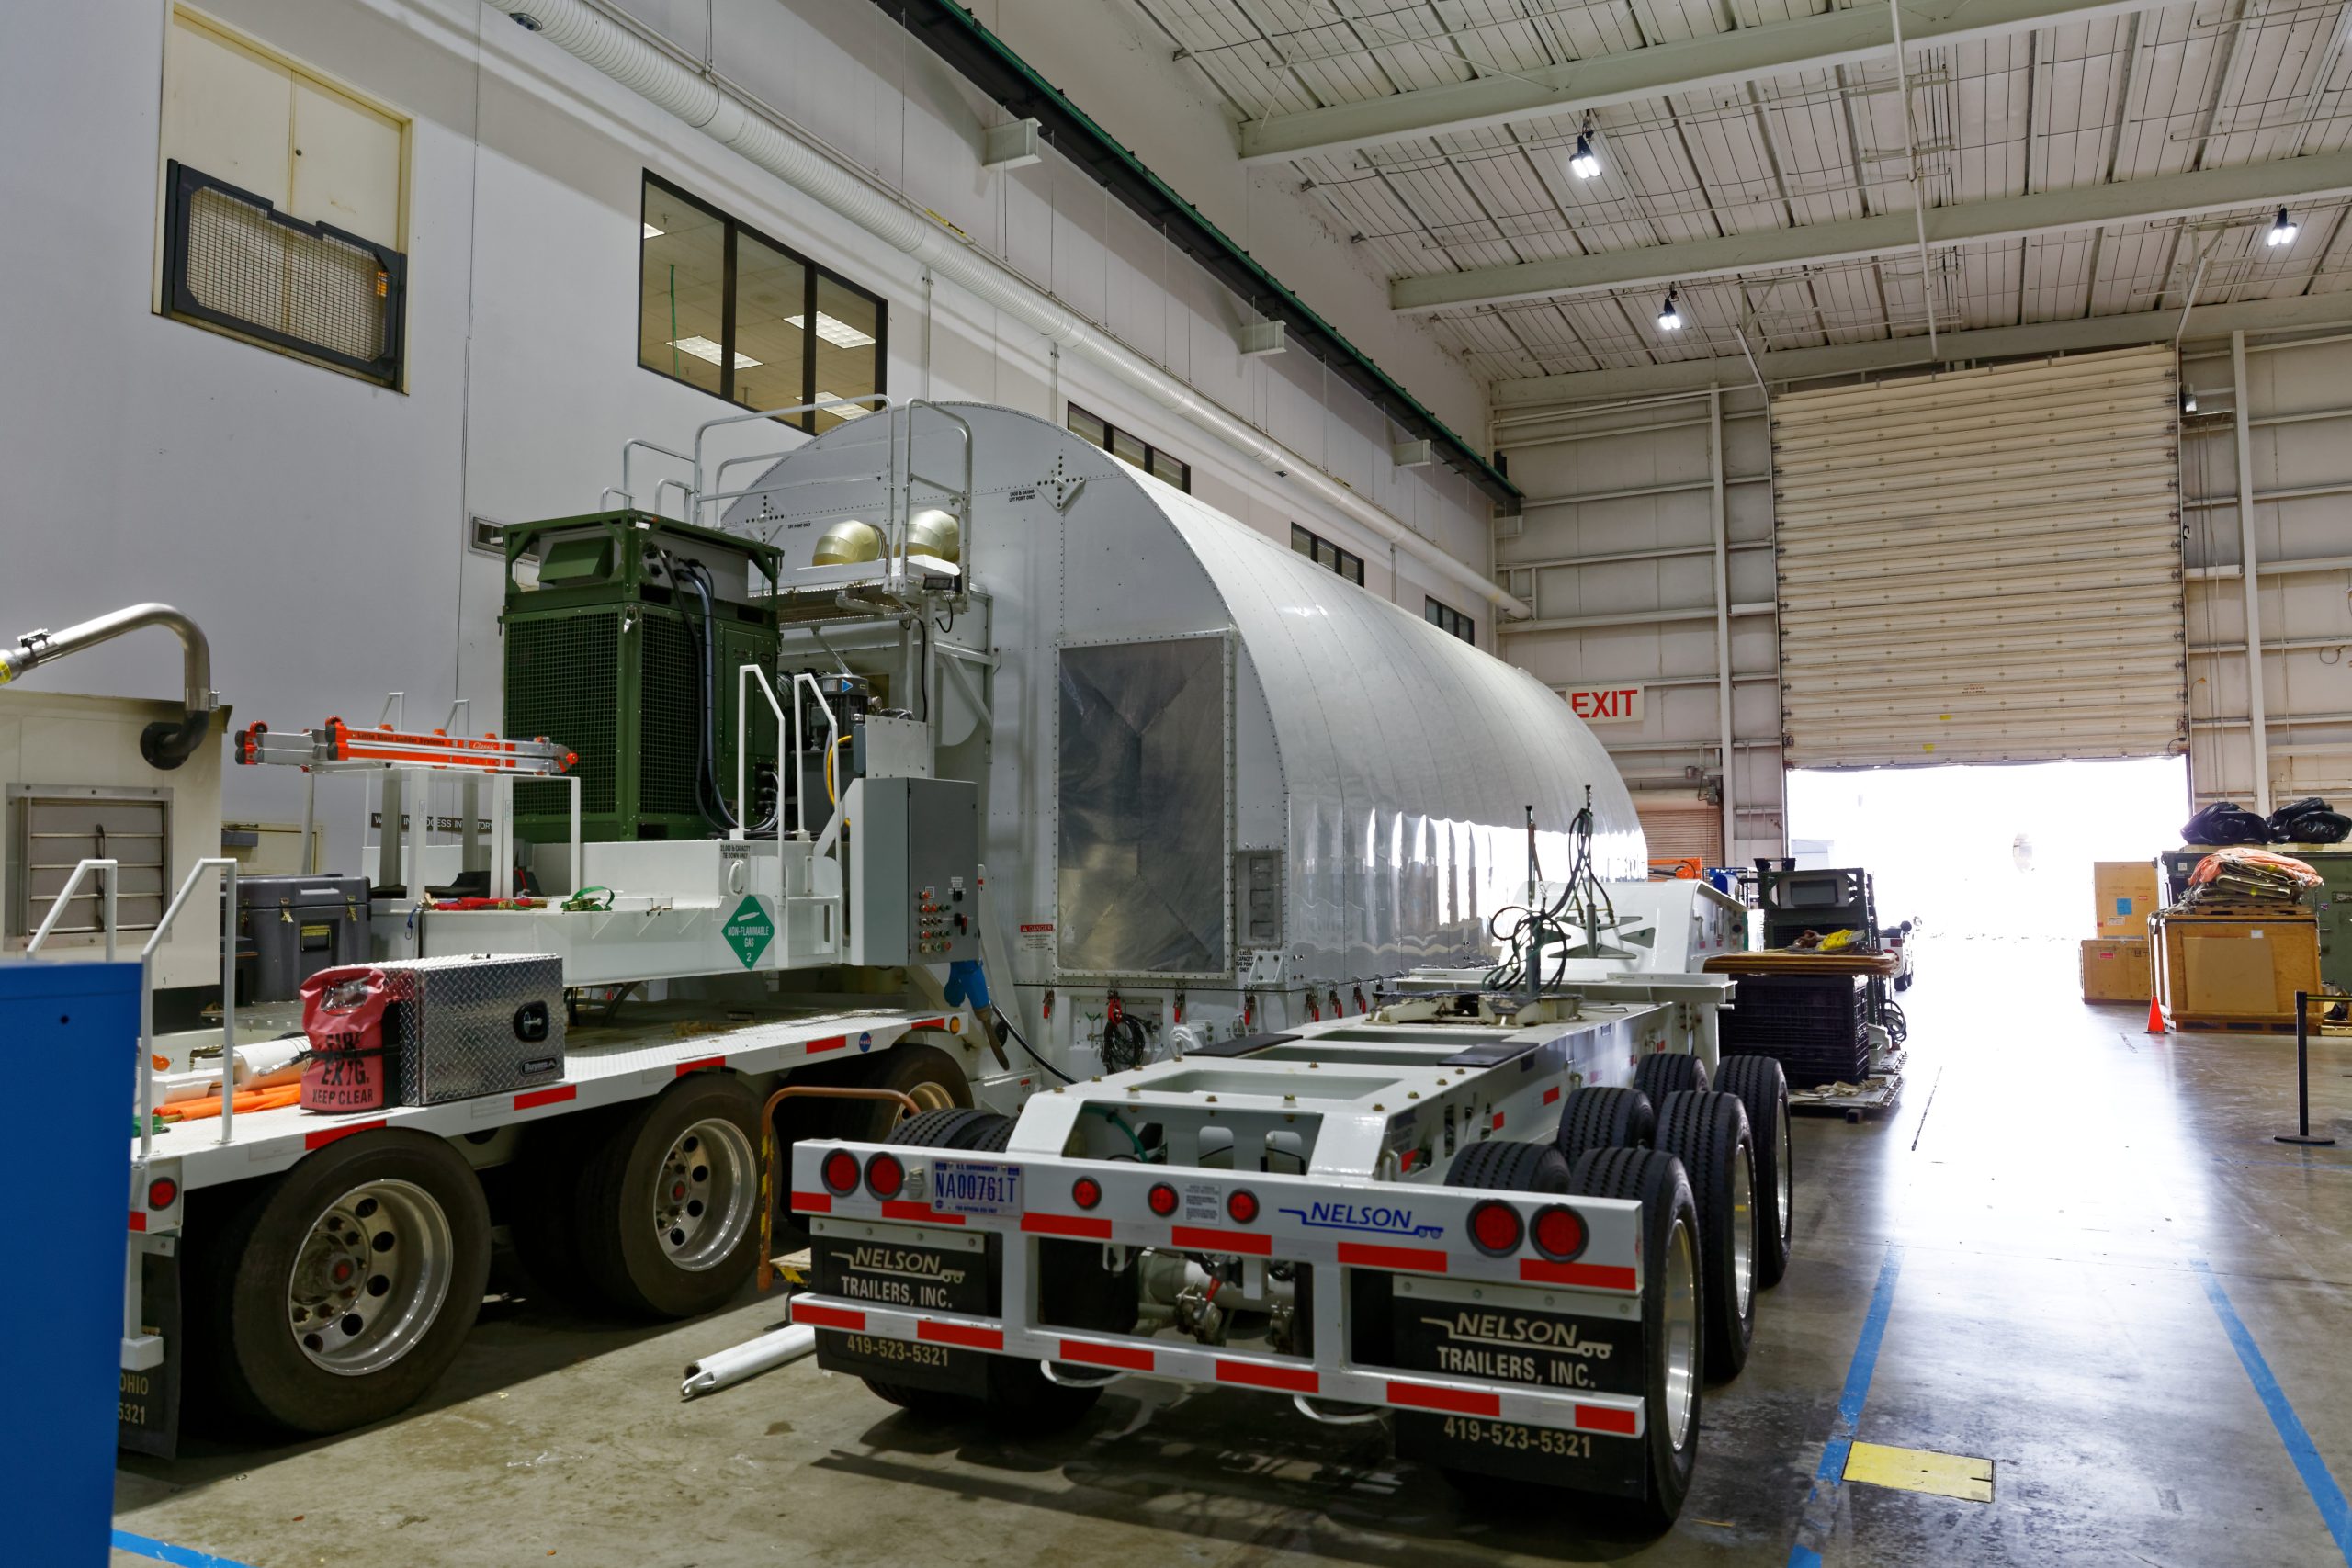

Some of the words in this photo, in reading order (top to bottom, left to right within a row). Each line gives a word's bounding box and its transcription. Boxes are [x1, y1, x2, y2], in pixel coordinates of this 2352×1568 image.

[1571, 689, 1638, 718] EXIT
[472, 742, 496, 750] Classic
[728, 926, 770, 936] NON-FLAMMABLE
[744, 937, 754, 947] GAS
[746, 952, 752, 962] 2
[312, 1089, 335, 1104] KEEP
[338, 1088, 374, 1105] CLEAR
[935, 1171, 1016, 1203] NA00761T
[1311, 1201, 1412, 1229] NELSON
[855, 1247, 941, 1275] NELSON
[841, 1275, 915, 1307] TRAILERS,
[920, 1286, 953, 1309] INC.
[1456, 1312, 1577, 1347] NELSON
[847, 1335, 949, 1367] 419-523-5321
[1436, 1345, 1544, 1385] TRAILERS,
[1550, 1359, 1596, 1388] INC.
[119, 1373, 149, 1395] OHIO
[1444, 1416, 1591, 1459] 419-523-5321
